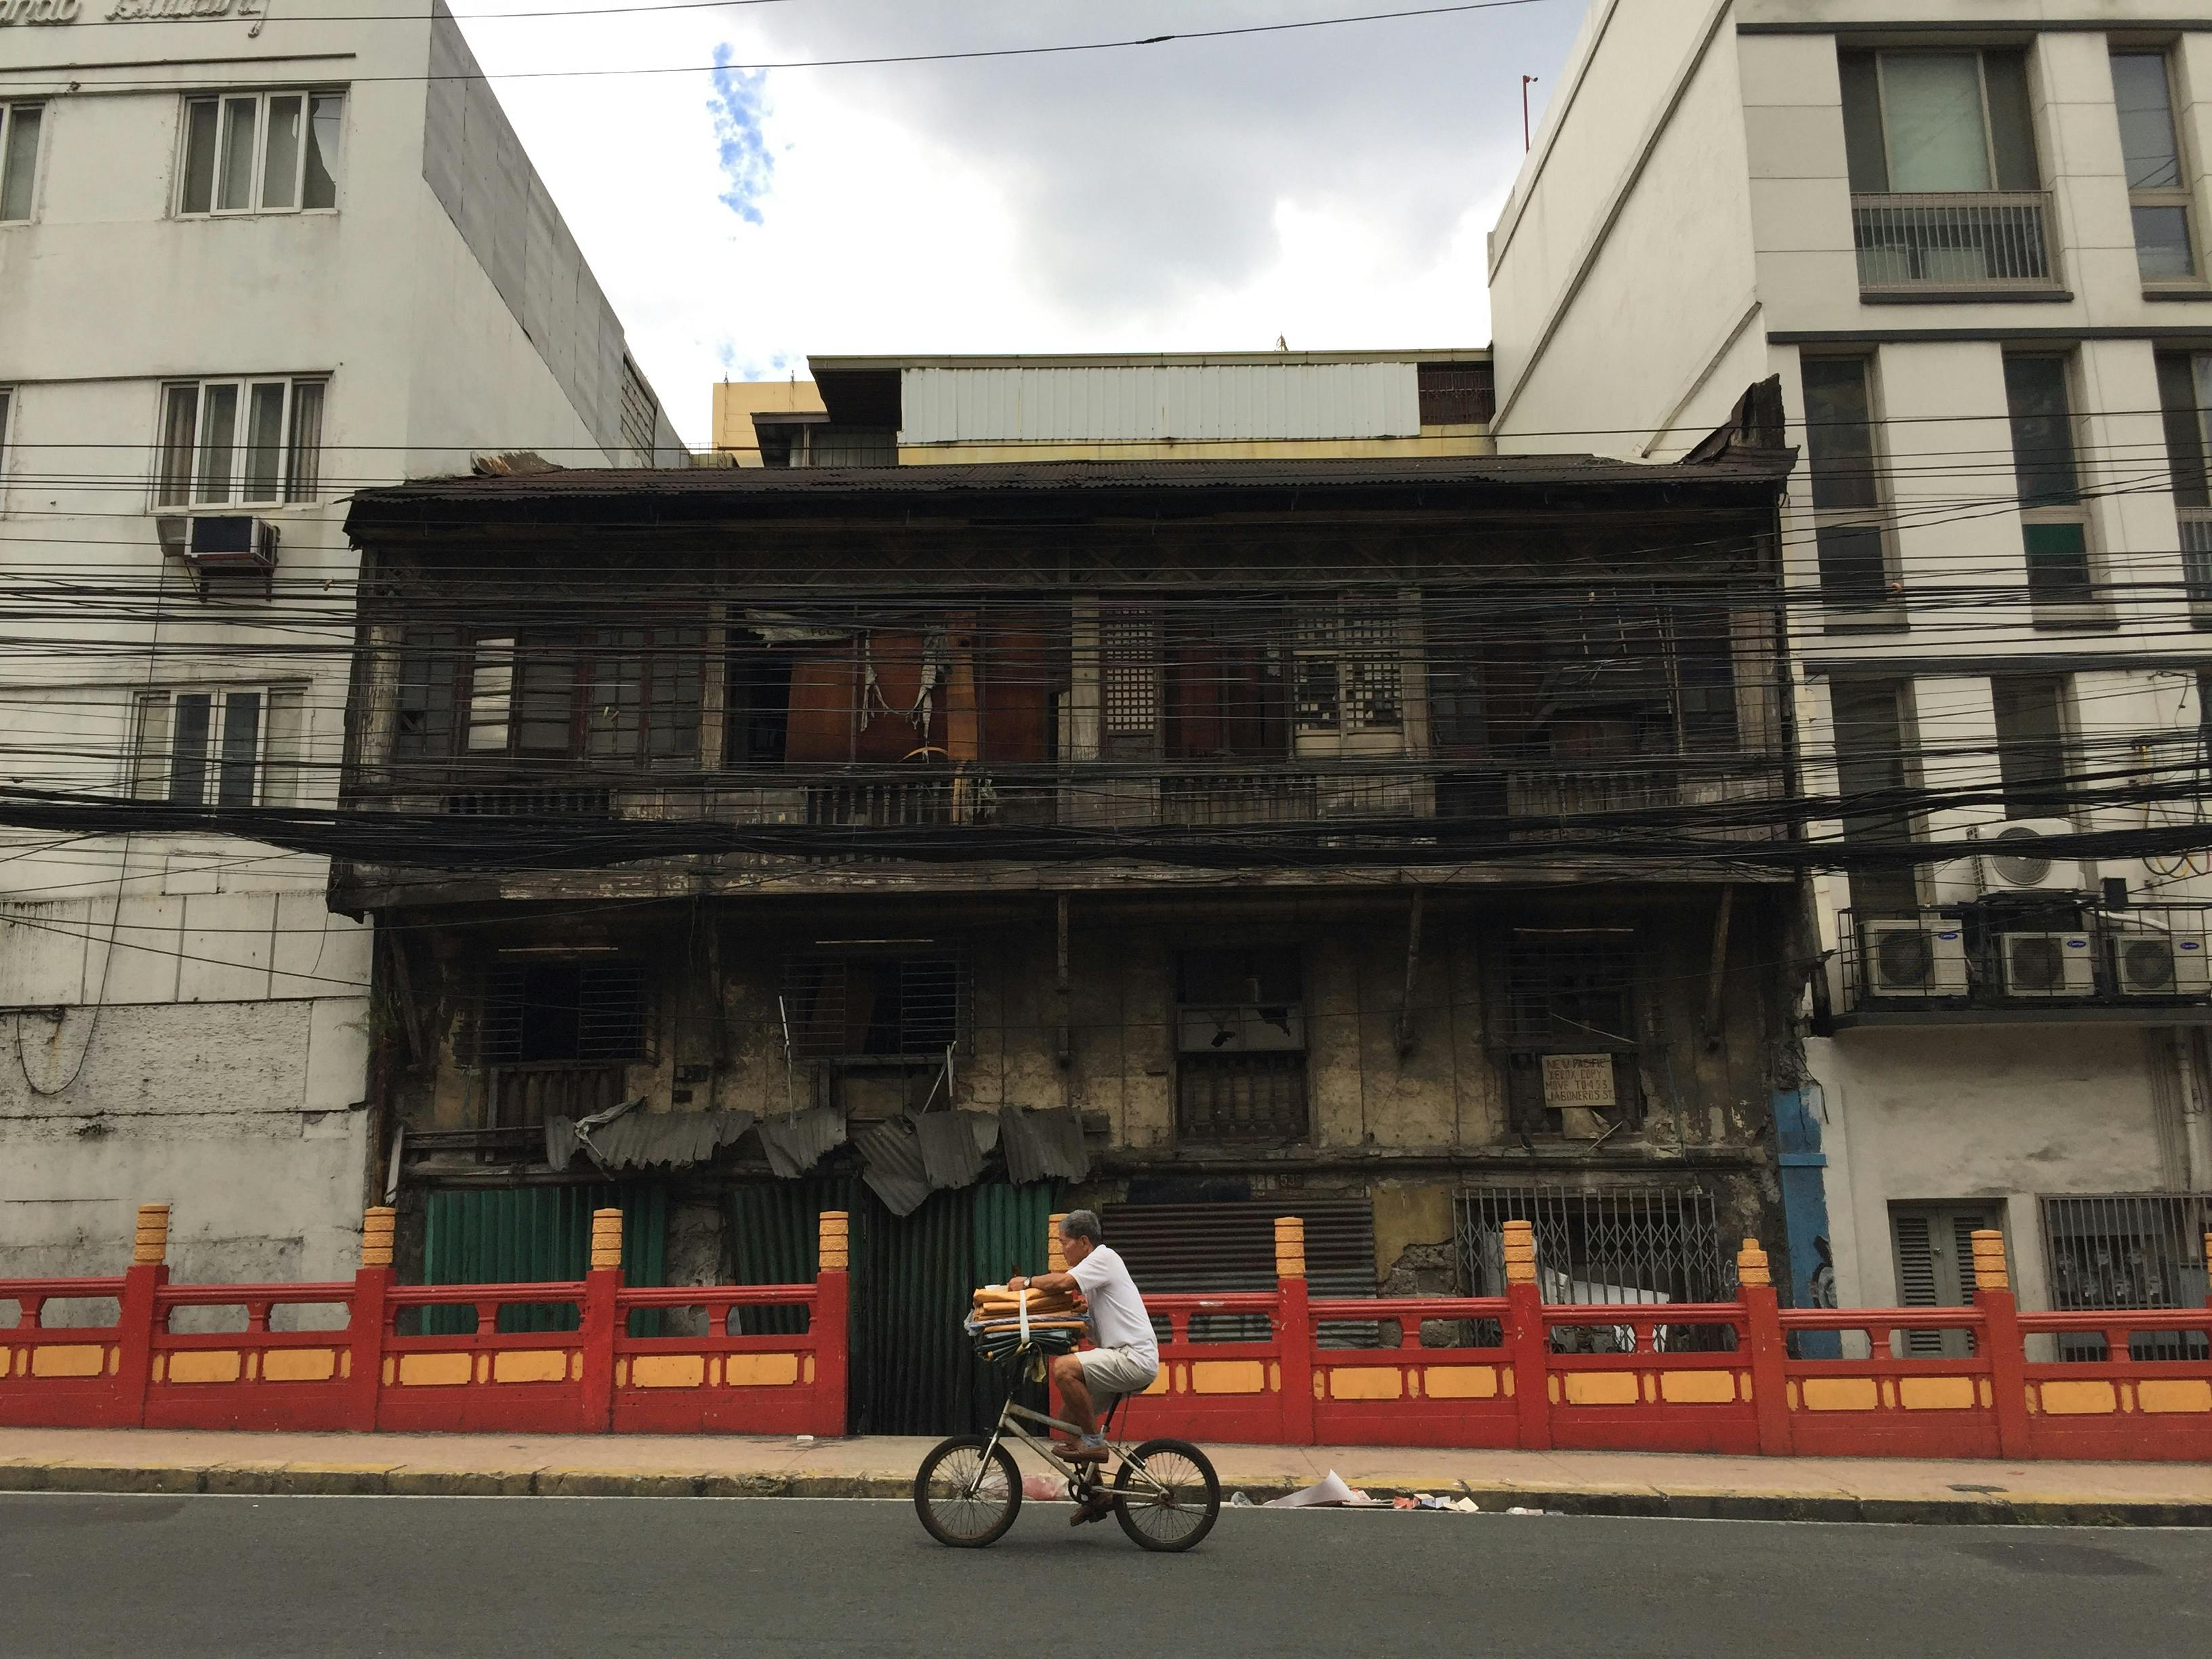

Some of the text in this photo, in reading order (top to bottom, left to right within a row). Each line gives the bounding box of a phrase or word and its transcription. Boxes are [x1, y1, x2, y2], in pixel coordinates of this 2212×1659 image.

[1547, 1059, 1570, 1069] NEW
[1580, 1069, 1602, 1080] COPY
[1545, 1080, 1569, 1090] MOVE
